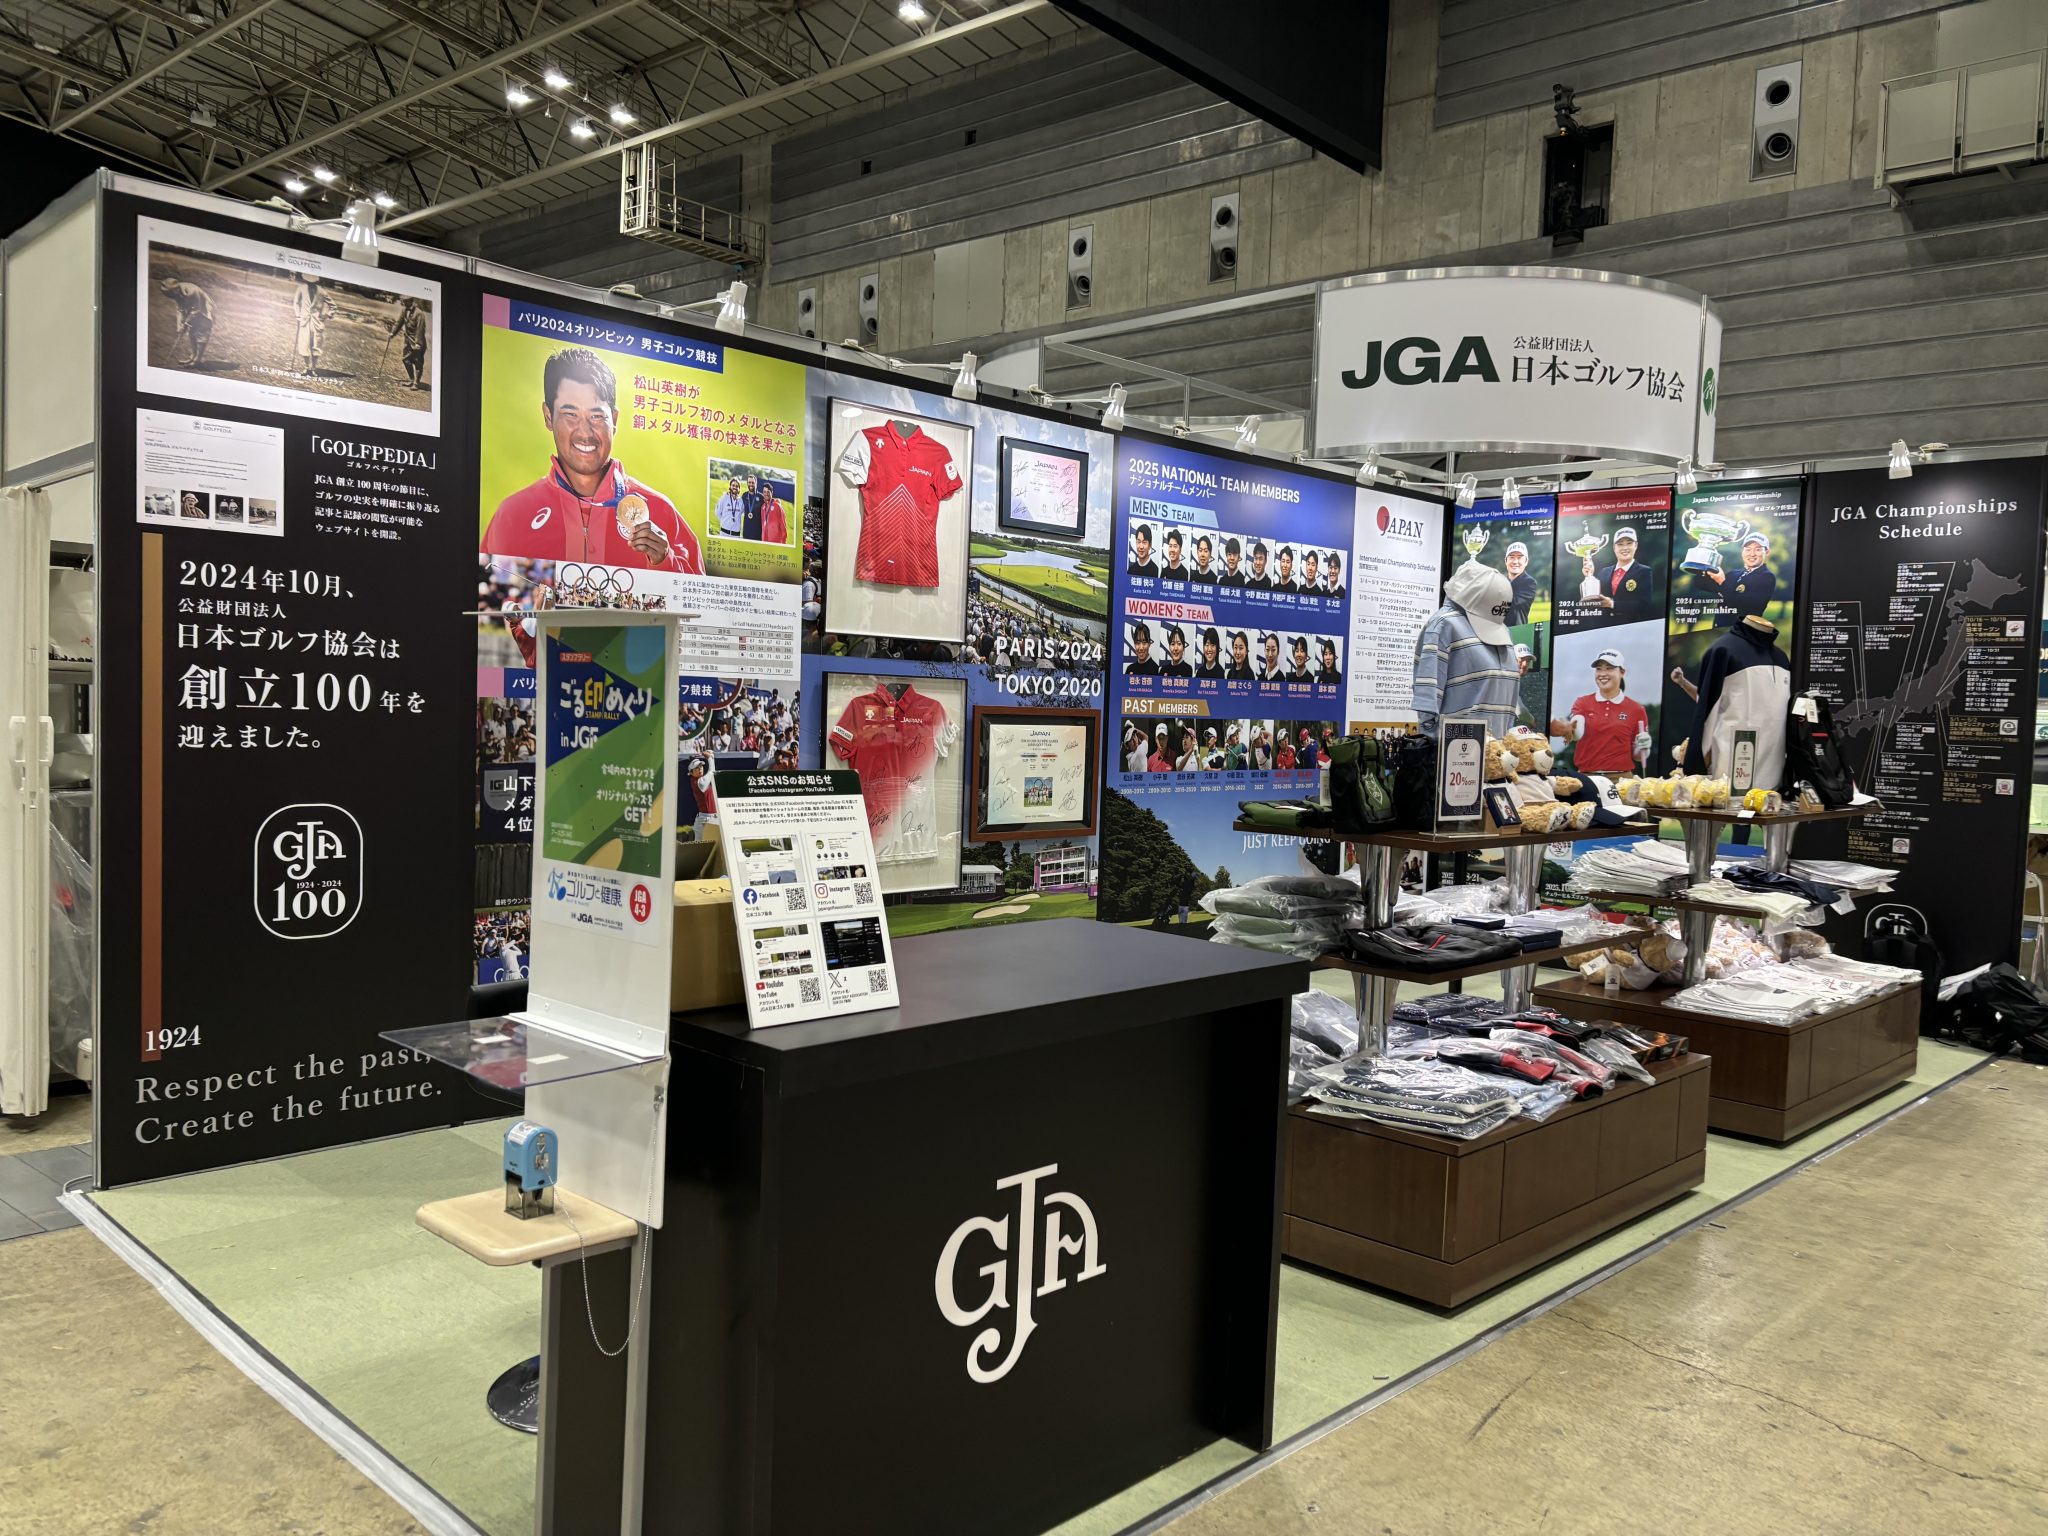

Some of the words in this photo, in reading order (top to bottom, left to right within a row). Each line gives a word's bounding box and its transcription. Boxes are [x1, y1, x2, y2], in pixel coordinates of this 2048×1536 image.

[518, 311, 635, 347] パリ2024オリンピック
[641, 337, 718, 365] 男子ゴルフ競技
[1513, 335, 1595, 354] 公益財団法人
[1341, 335, 1500, 390] JGA
[633, 374, 700, 399] 松山英樹が
[1512, 354, 1685, 403] 日本ゴルフ協会
[633, 395, 797, 438] 男子ゴルフ初のメダルとなる
[632, 414, 797, 456] 銅メダル獲得の快挙を果たす
[346, 460, 405, 474] ゴルフペディア
[1129, 458, 1159, 477] 2025
[1161, 461, 1218, 488] NATIONAL
[1220, 477, 1249, 495] TEAM
[1252, 483, 1300, 503] MEMBERS
[1129, 475, 1216, 499] ナショナルチームメンバー
[315, 491, 440, 513] ゴルフの史実を明確に振り返る
[1740, 492, 1782, 500] Championship
[314, 506, 423, 527] 記事と記録の閲覧が可能な
[1131, 499, 1169, 518] MEN'S
[1172, 509, 1195, 523] TEAM
[1831, 506, 1867, 523] JGA
[1875, 499, 2018, 520] Championships
[315, 523, 402, 541] ウェブサイトを開設。
[1381, 515, 1424, 538] JAPAN
[1879, 523, 1962, 541] Schedule
[1360, 554, 1387, 564] International
[1388, 558, 1416, 569] Championship
[1417, 563, 1436, 571] Schedule
[179, 560, 354, 598] 2024年10月、
[177, 597, 287, 619] 公益財団法人
[1128, 600, 1183, 618] WOMEN'S
[1187, 609, 1209, 621] TEAM
[1559, 609, 1572, 617] Rio
[1675, 606, 1700, 615] Shugo
[1702, 606, 1738, 614] Imahira
[177, 622, 400, 659] 日本ゴルフ協会は
[996, 636, 1055, 660] PARIS
[1059, 641, 1102, 662] 2024
[561, 653, 592, 662] スタンプラリー
[177, 663, 426, 713] 創立100年を
[512, 677, 537, 690] パリ
[995, 673, 1055, 695] TOKYO
[1059, 676, 1101, 697] 2020
[560, 677, 652, 720] ごる印めぐり
[1124, 699, 1154, 713] PAST
[1158, 703, 1198, 714] MEMBERS
[585, 711, 601, 719] STAMP
[603, 712, 619, 720] RALLY
[177, 724, 321, 749] 迎えました。
[561, 732, 569, 747] in
[1446, 725, 1474, 739] SALE
[601, 764, 654, 779] 会場内のスタンプを
[747, 775, 832, 786] 公式SNSのお知らせ
[503, 776, 536, 792] 山下
[504, 796, 535, 812] メダ
[596, 789, 652, 806] オリジナルグッズを
[624, 807, 652, 824] GET!
[1243, 834, 1267, 853] JUST
[1271, 833, 1297, 847] KEEP
[272, 881, 346, 921] 100
[635, 890, 646, 903] JGA
[759, 891, 780, 899] Facebook
[577, 912, 593, 924] JGA
[634, 903, 646, 917] 4-3
[145, 1025, 201, 1052] 1924
[135, 1065, 277, 1104] Respect
[294, 1053, 345, 1080] the
[360, 1049, 431, 1077] past,
[135, 1109, 254, 1144] Create
[272, 1096, 324, 1122] the
[339, 1080, 442, 1111] future.
